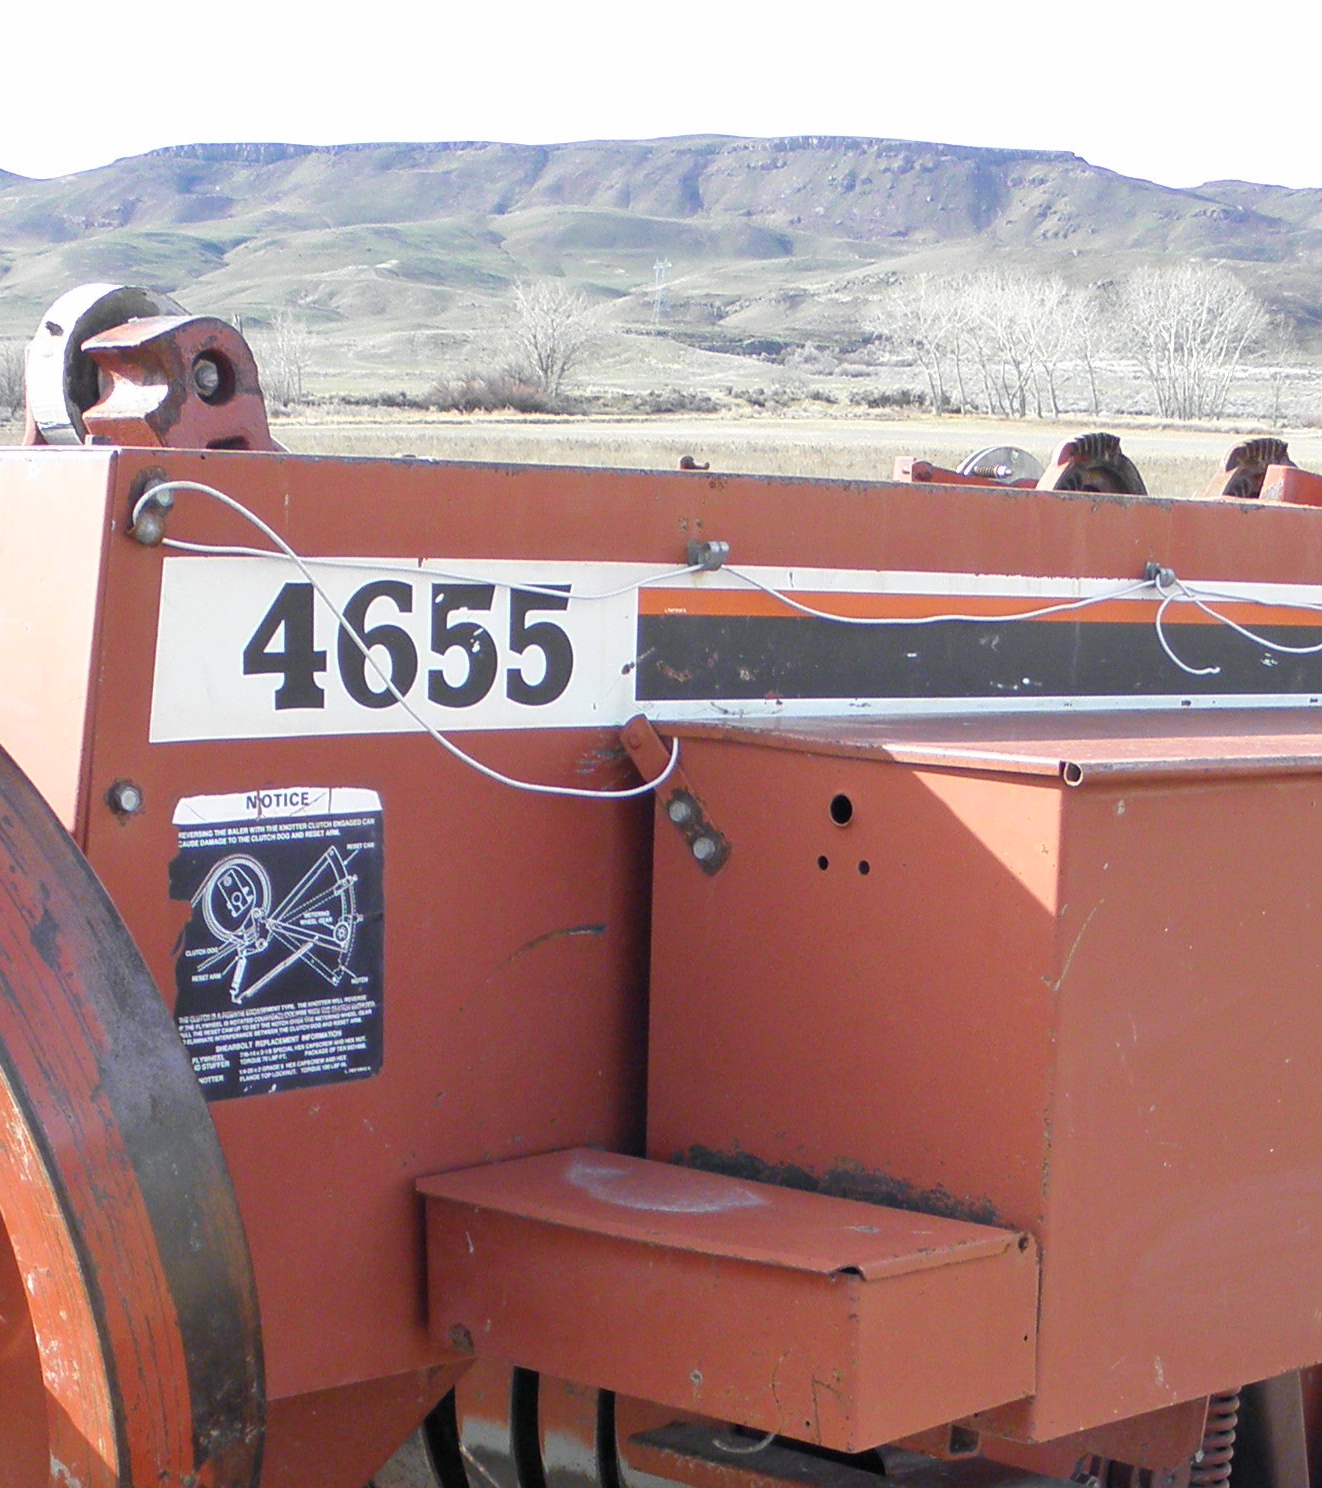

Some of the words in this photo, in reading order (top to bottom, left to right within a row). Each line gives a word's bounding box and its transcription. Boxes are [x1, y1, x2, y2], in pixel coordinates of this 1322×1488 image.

[243, 580, 573, 710] 4655
[246, 792, 309, 809] NOTICE
[227, 827, 248, 835] BALER
[278, 823, 306, 831] KNOTTER
[307, 821, 332, 829] CLUTCH
[332, 819, 361, 827] ENGAGED
[200, 837, 226, 845] DAMAGE
[251, 833, 276, 841] CLUTCH
[215, 1041, 252, 1052] SHEARBOLT
[254, 1035, 299, 1047] REPLACEMENT
[301, 1029, 341, 1041] INFORMATION
[192, 1054, 224, 1065] FLYWHEEL
[201, 1060, 230, 1071] STUFFER
[198, 1075, 224, 1084] NOTTER
